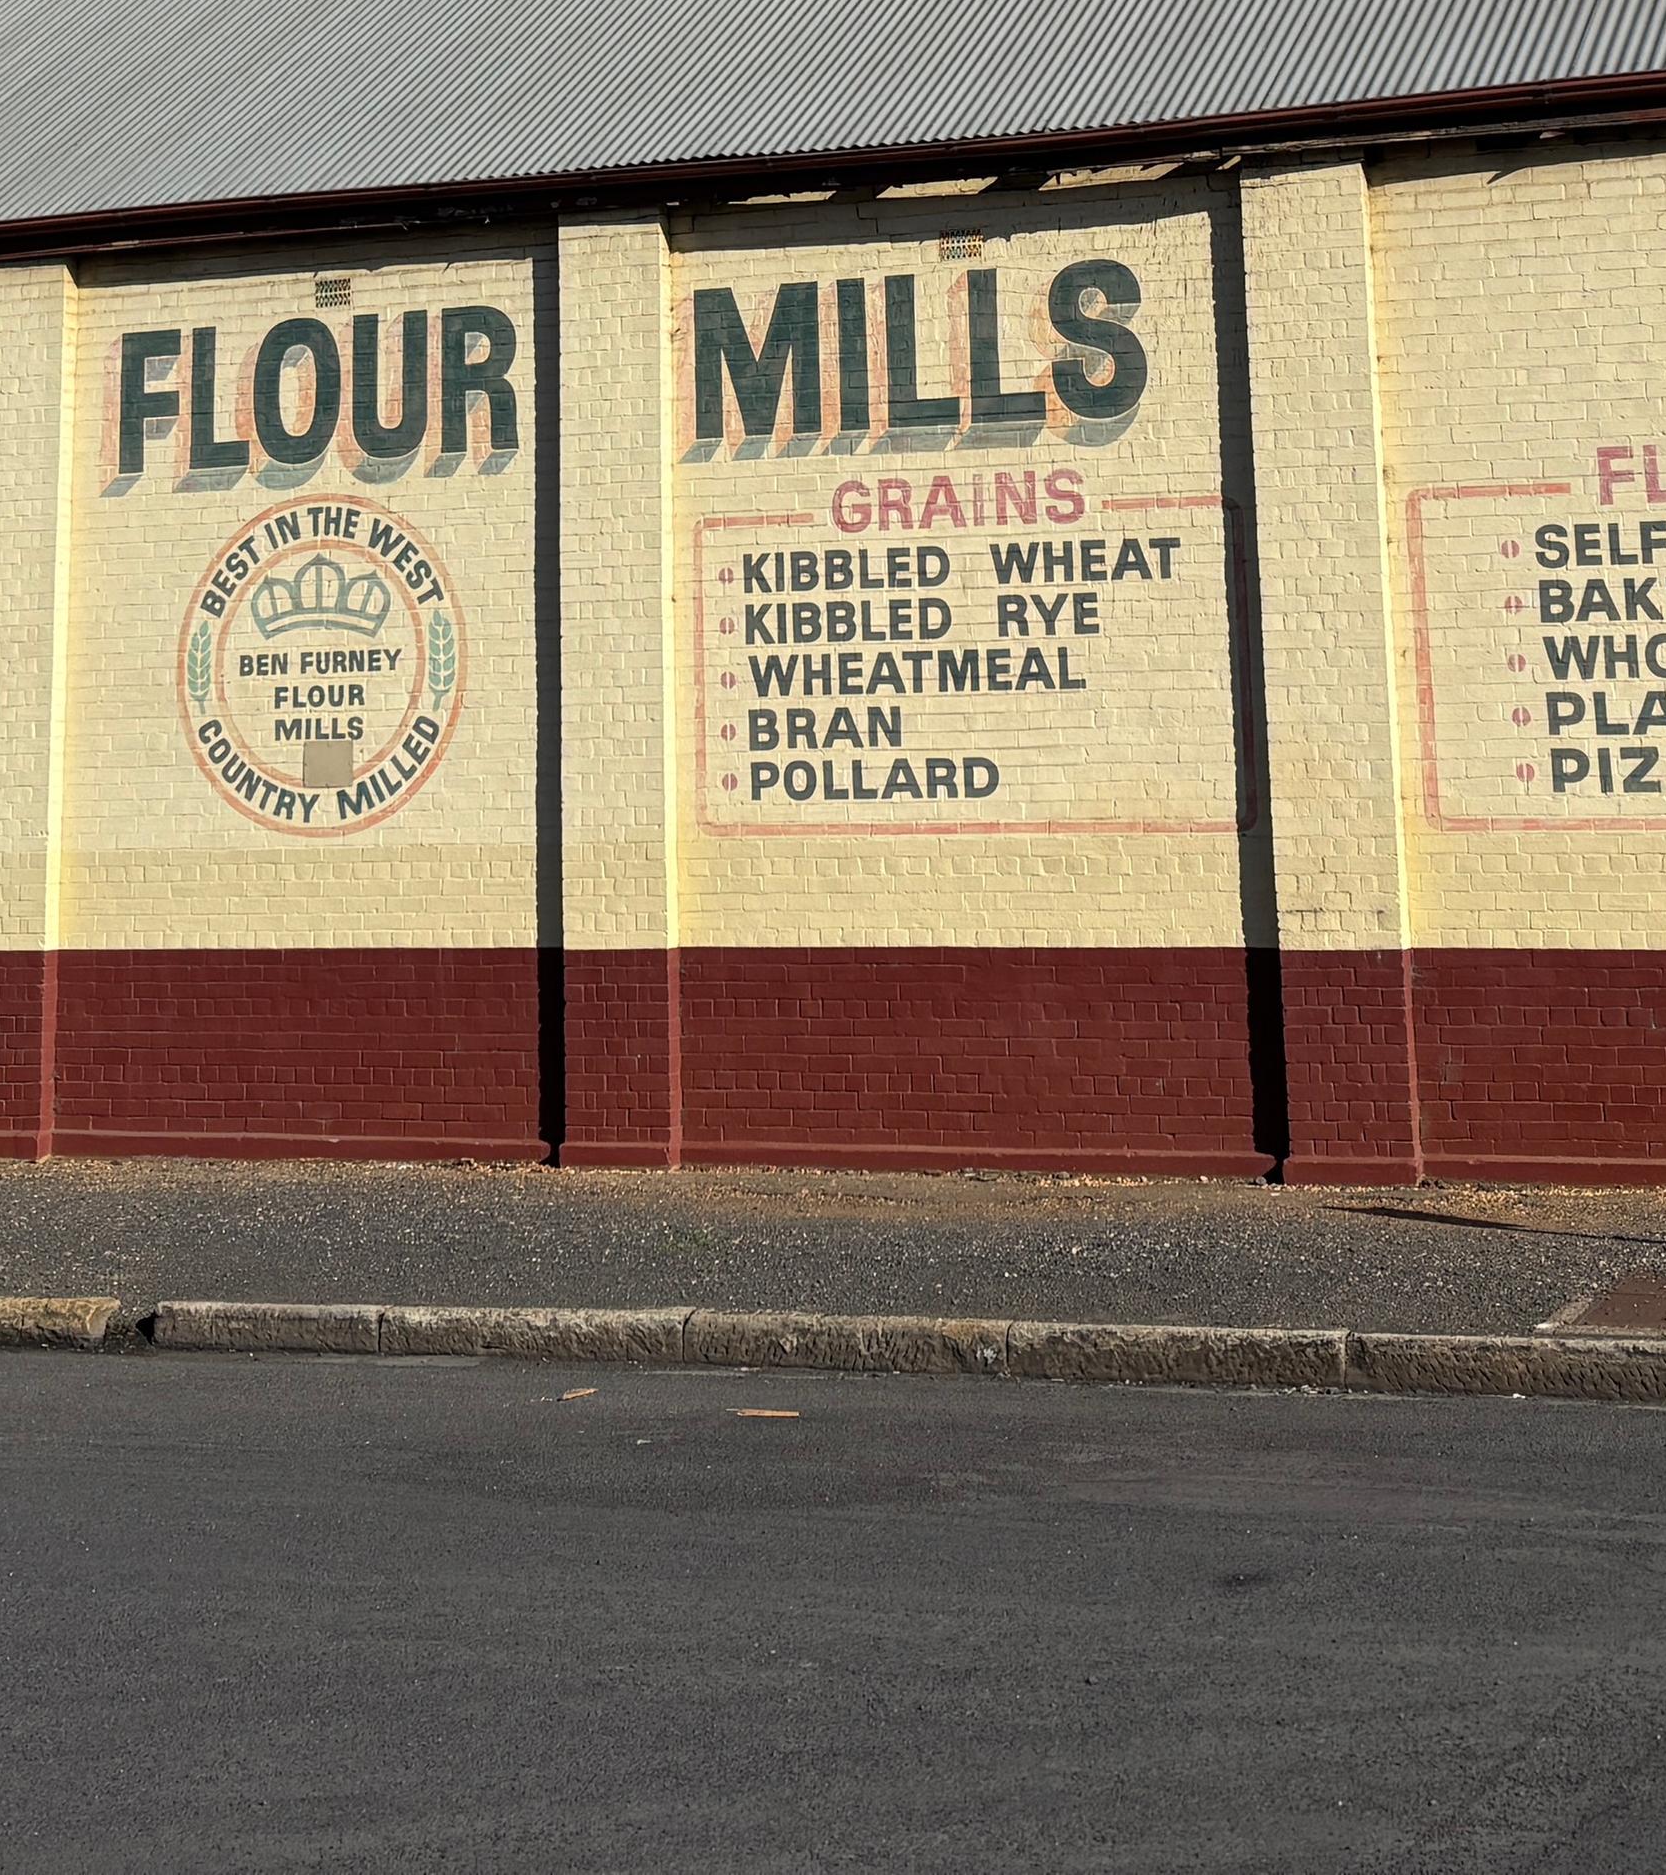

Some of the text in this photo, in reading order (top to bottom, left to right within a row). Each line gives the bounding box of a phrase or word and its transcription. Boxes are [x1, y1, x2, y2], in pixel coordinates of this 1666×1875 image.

[111, 305, 520, 486] FLOUR
[686, 258, 1147, 453] MILLS
[832, 469, 1085, 533] GRAINS
[200, 506, 444, 618] BEST IN THE WEST
[742, 537, 1181, 594] KIBBLED WHEAT
[744, 592, 1100, 645] KIBBLED RYE
[239, 648, 402, 677] BEN FURNEY
[748, 646, 1087, 698] WHEATMEAL
[274, 685, 365, 709] FLOUR
[275, 717, 364, 741] MILLS
[748, 706, 902, 752] BRAN
[198, 715, 440, 823] COUNTRY MILLED
[751, 757, 1000, 801] POLLARD
